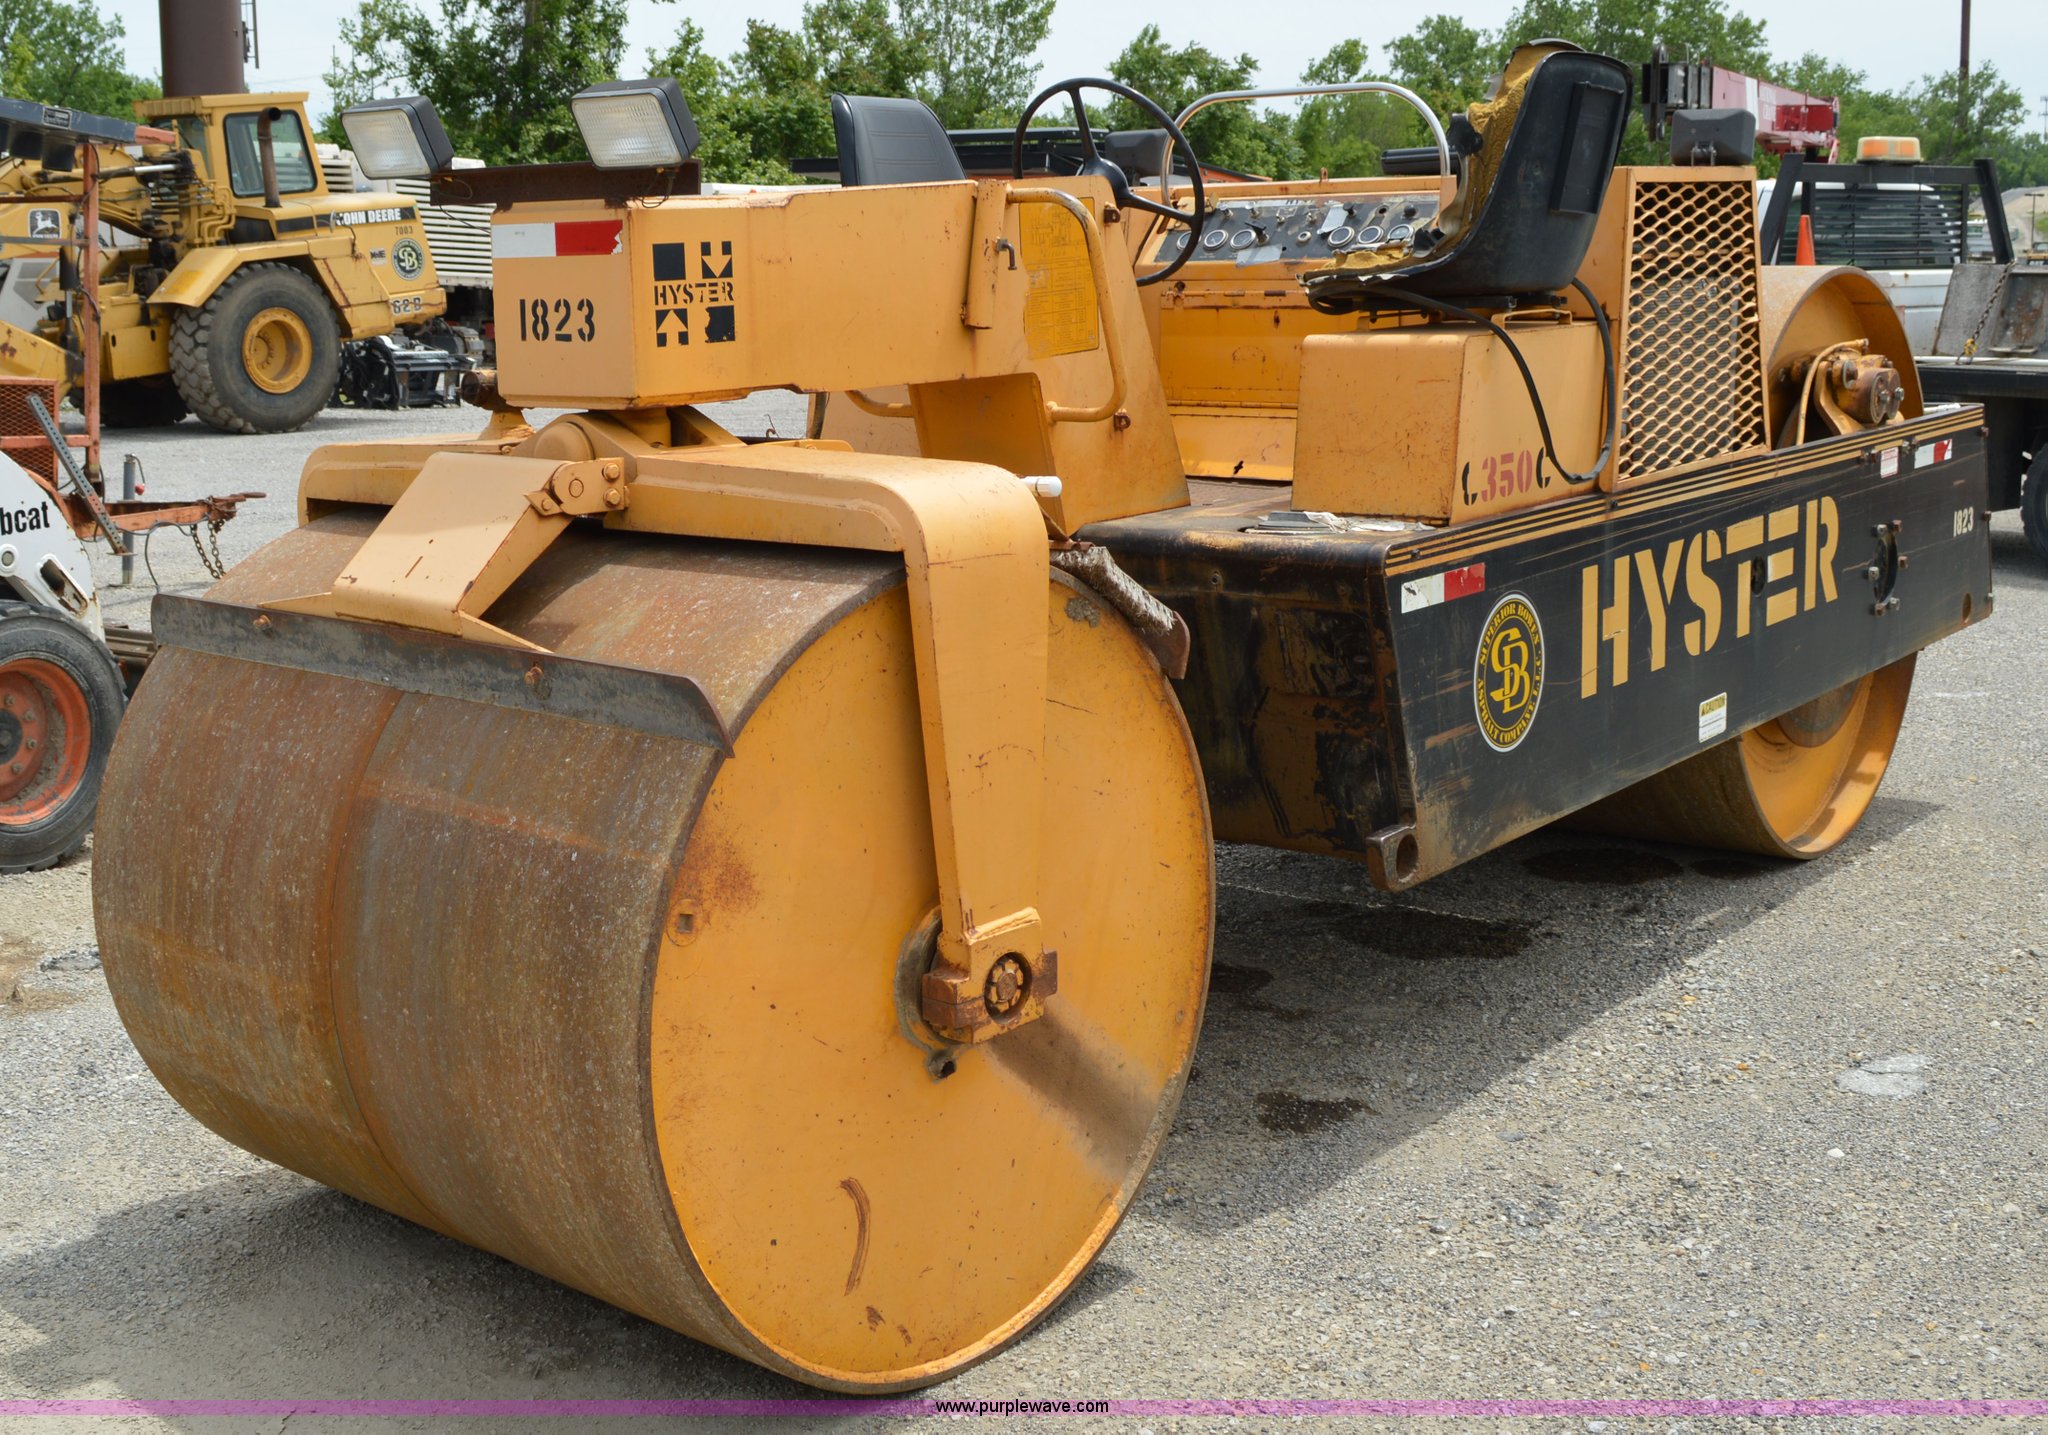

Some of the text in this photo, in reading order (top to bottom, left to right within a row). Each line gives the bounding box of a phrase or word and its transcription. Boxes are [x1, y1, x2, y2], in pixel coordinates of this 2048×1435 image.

[367, 208, 401, 223] DEERE
[654, 281, 735, 306] HYSTER
[519, 298, 595, 343] 1823
[1953, 506, 1974, 537] 1823
[1581, 496, 1839, 699] HYSTER
[1480, 603, 1540, 666] SUPERIOR BOWEN
[1477, 678, 1499, 741] ASPHALT
